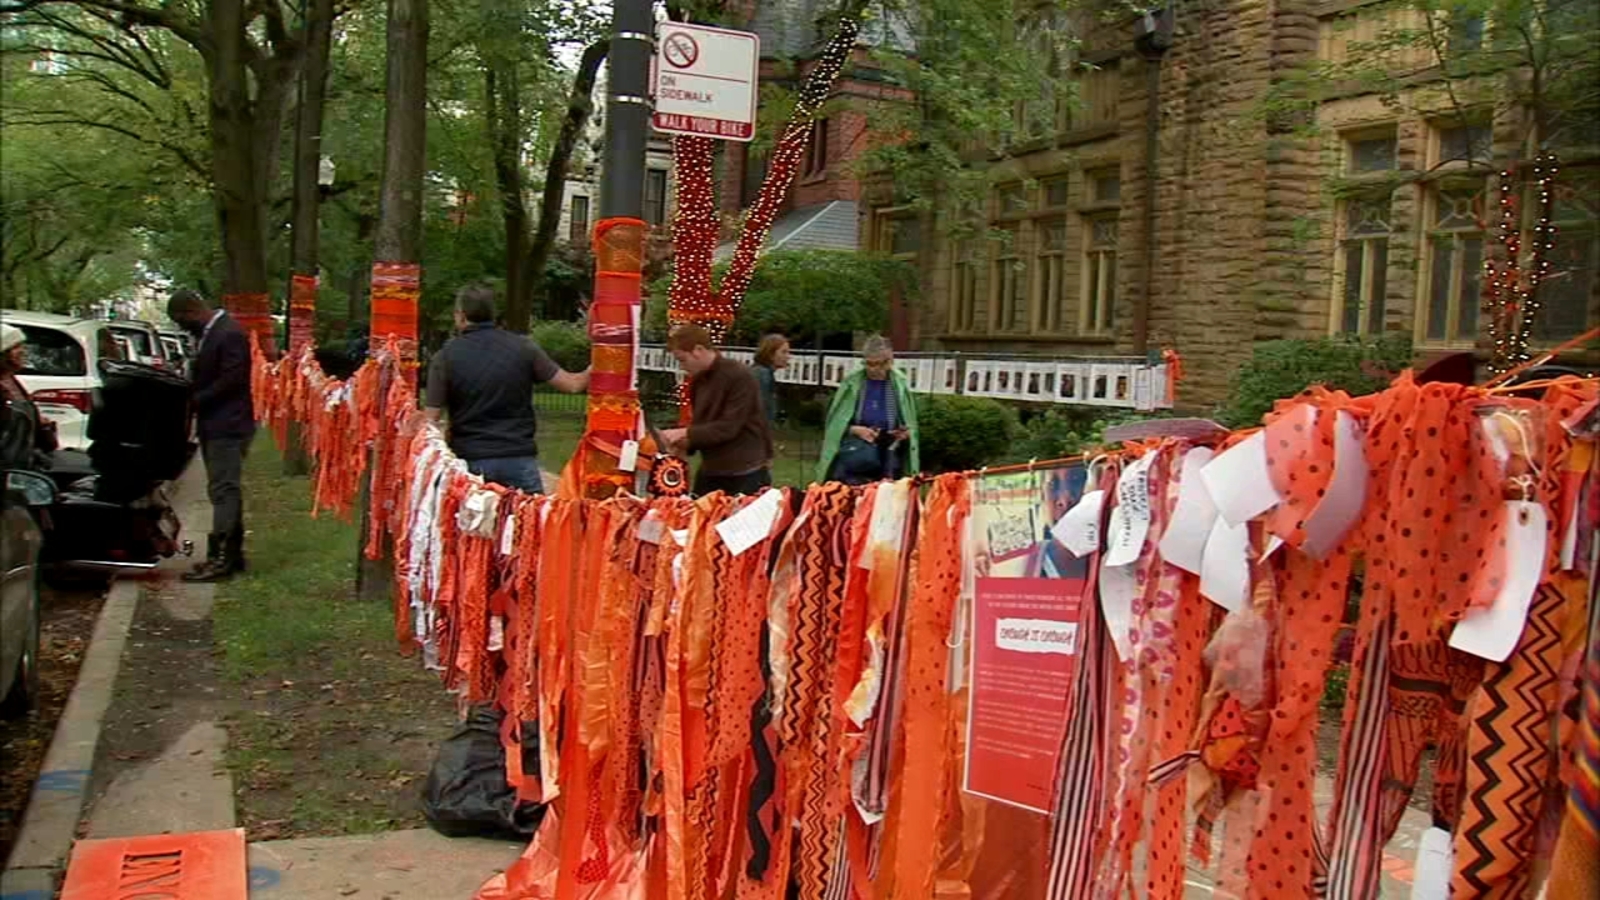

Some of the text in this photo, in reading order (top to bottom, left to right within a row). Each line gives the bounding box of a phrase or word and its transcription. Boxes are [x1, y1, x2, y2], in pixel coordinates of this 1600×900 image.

[660, 75, 676, 87] ON
[660, 88, 712, 102] SIDEWALK
[658, 114, 745, 136] WALK YOUR BIKE
